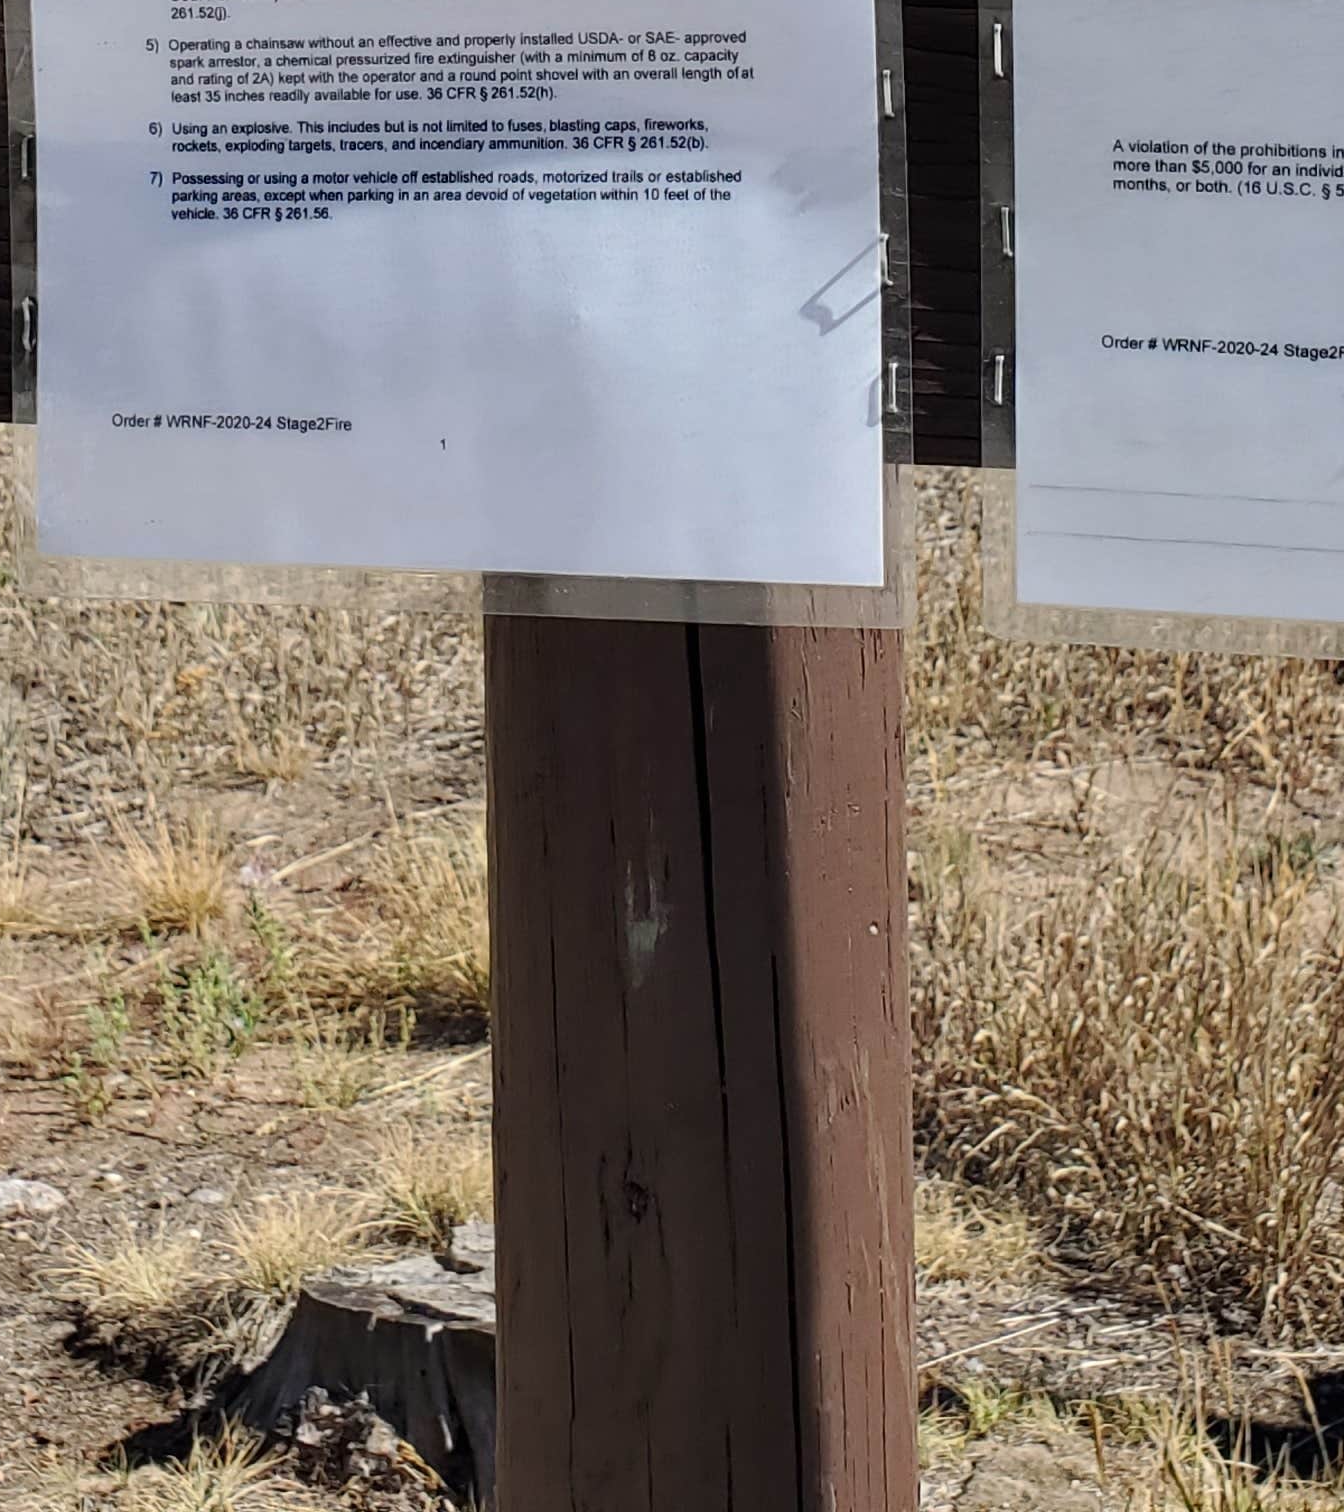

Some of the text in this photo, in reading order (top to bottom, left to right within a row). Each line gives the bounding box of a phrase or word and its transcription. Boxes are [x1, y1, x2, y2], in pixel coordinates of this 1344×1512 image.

[171, 206, 219, 220] vehicle.
[222, 206, 239, 220] 36
[242, 206, 270, 220] CFR
[285, 206, 332, 220] 261.56.
[1101, 334, 1144, 349] Order
[1147, 337, 1157, 350] #
[1162, 337, 1279, 356] WRNF-2020-24
[111, 413, 352, 433] Order # WRNF-2020-24 Stage2Fire
[440, 438, 445, 450] 1
